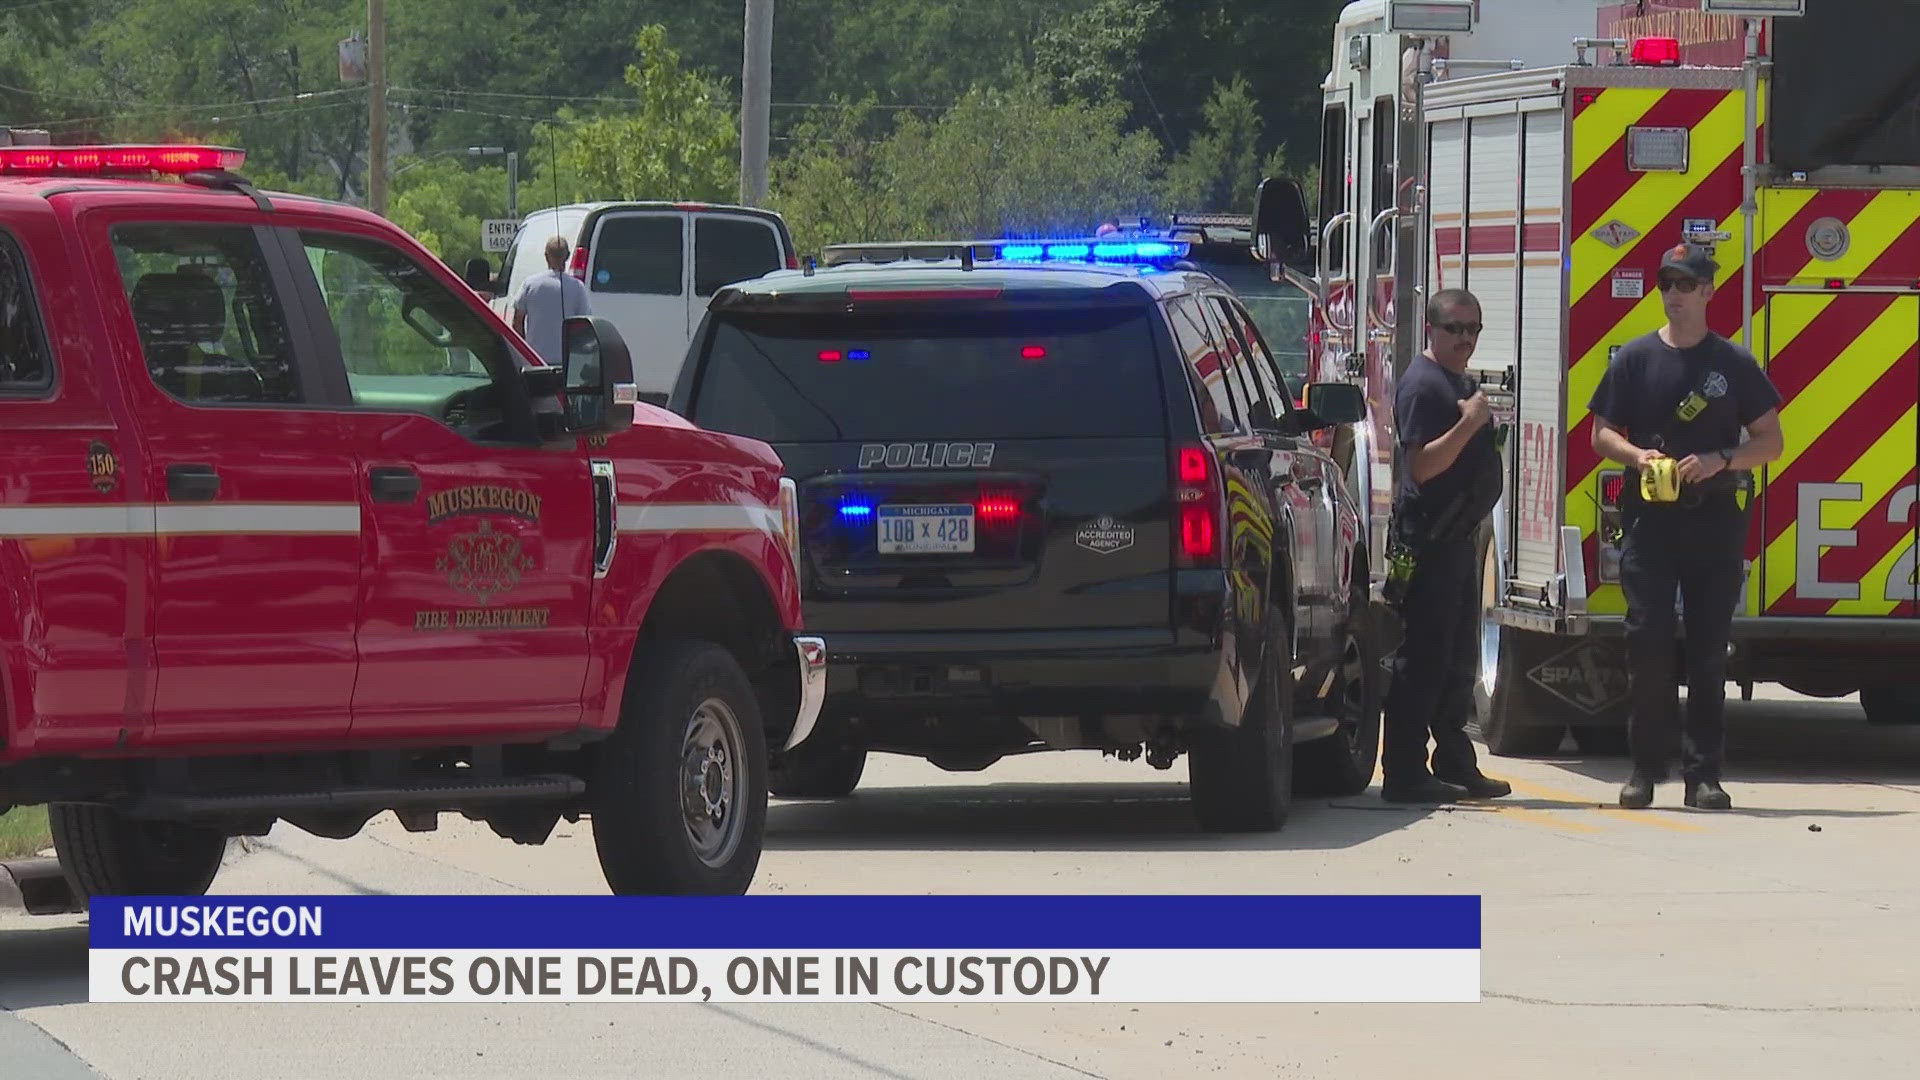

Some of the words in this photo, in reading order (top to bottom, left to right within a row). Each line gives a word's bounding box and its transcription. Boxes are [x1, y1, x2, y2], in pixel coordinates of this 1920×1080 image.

[1679, 8, 1738, 46] DEPARTMENT
[488, 223, 520, 234] ENTRA
[91, 453, 114, 475] 150
[858, 443, 995, 469] POLICE
[1521, 423, 1553, 541] E24
[426, 485, 542, 520] MUSKEGON
[902, 507, 950, 515] MICHIGAN
[883, 519, 914, 542] 108
[938, 518, 969, 541] 428
[1079, 531, 1131, 540] ACCREDITED
[1090, 540, 1120, 548] AGENCY
[415, 611, 449, 629] FIRE
[455, 608, 549, 628] DEPARTMENT
